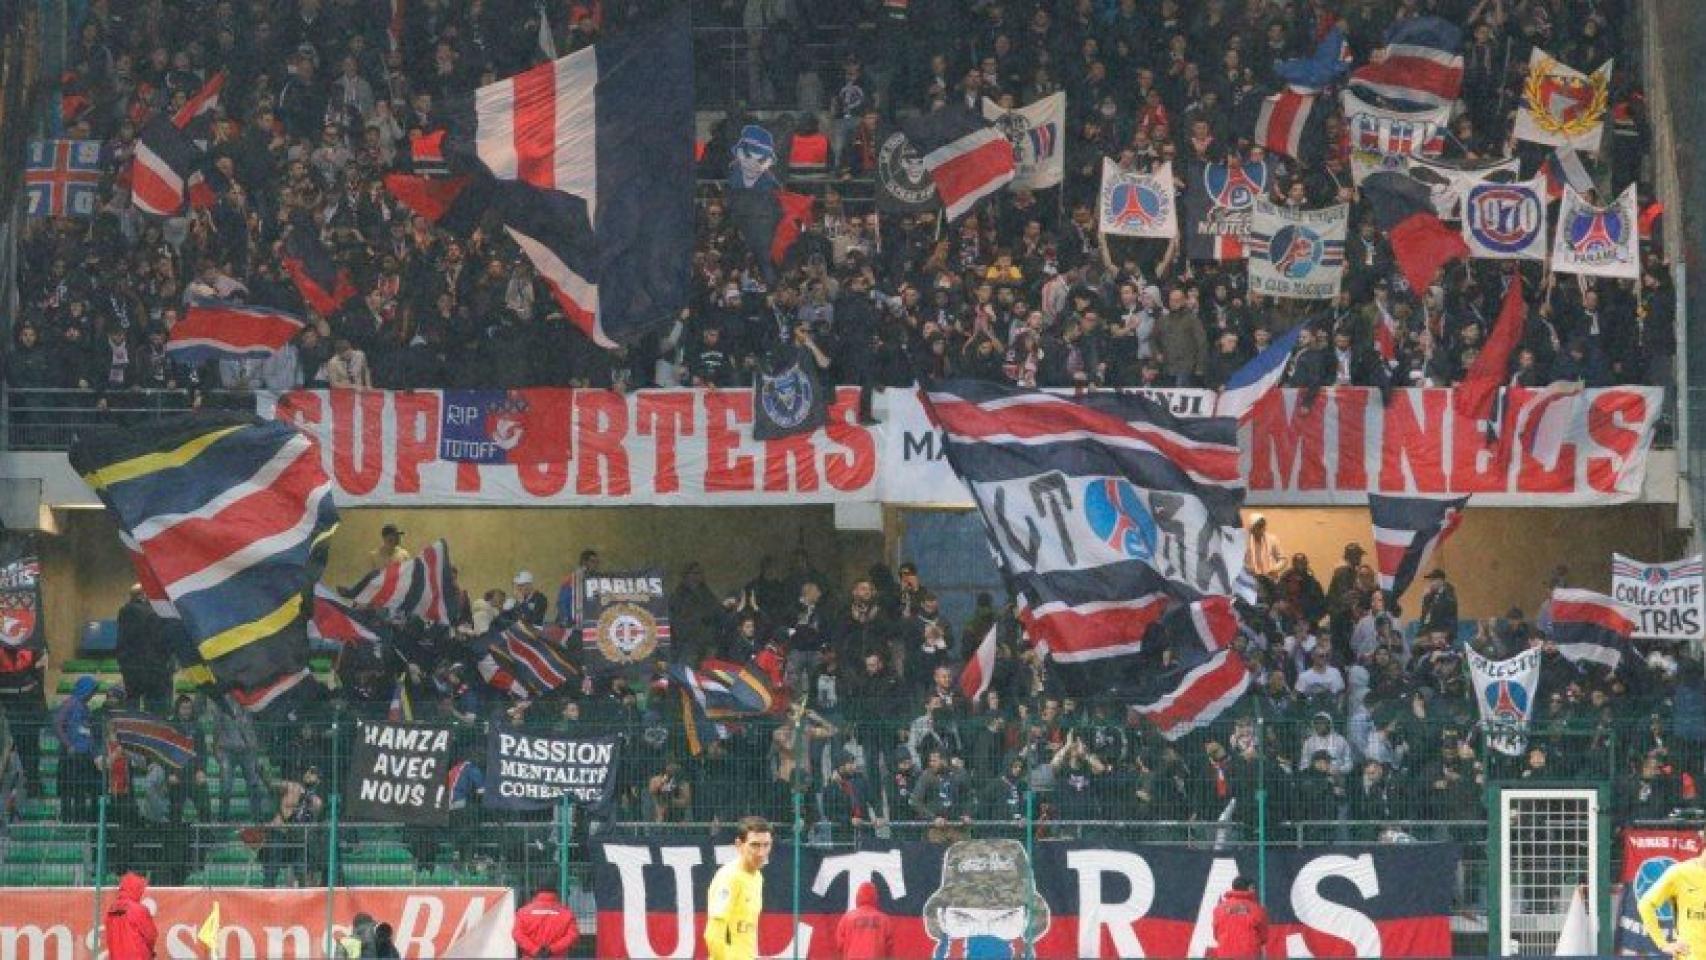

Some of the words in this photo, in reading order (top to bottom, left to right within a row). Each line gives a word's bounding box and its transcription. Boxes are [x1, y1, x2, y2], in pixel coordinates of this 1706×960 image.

[446, 404, 479, 425] RIP
[274, 388, 876, 497] SUPRTERS
[443, 438, 498, 459] TOTOFF
[586, 577, 663, 600] PARIAS
[1616, 583, 1700, 606] COLLECTIF
[1634, 608, 1701, 635] TRAS
[365, 725, 449, 751] HAMZA
[500, 734, 614, 764] PASSION
[373, 753, 435, 779] AVEC
[361, 779, 425, 807] NOUS
[433, 784, 445, 809] !
